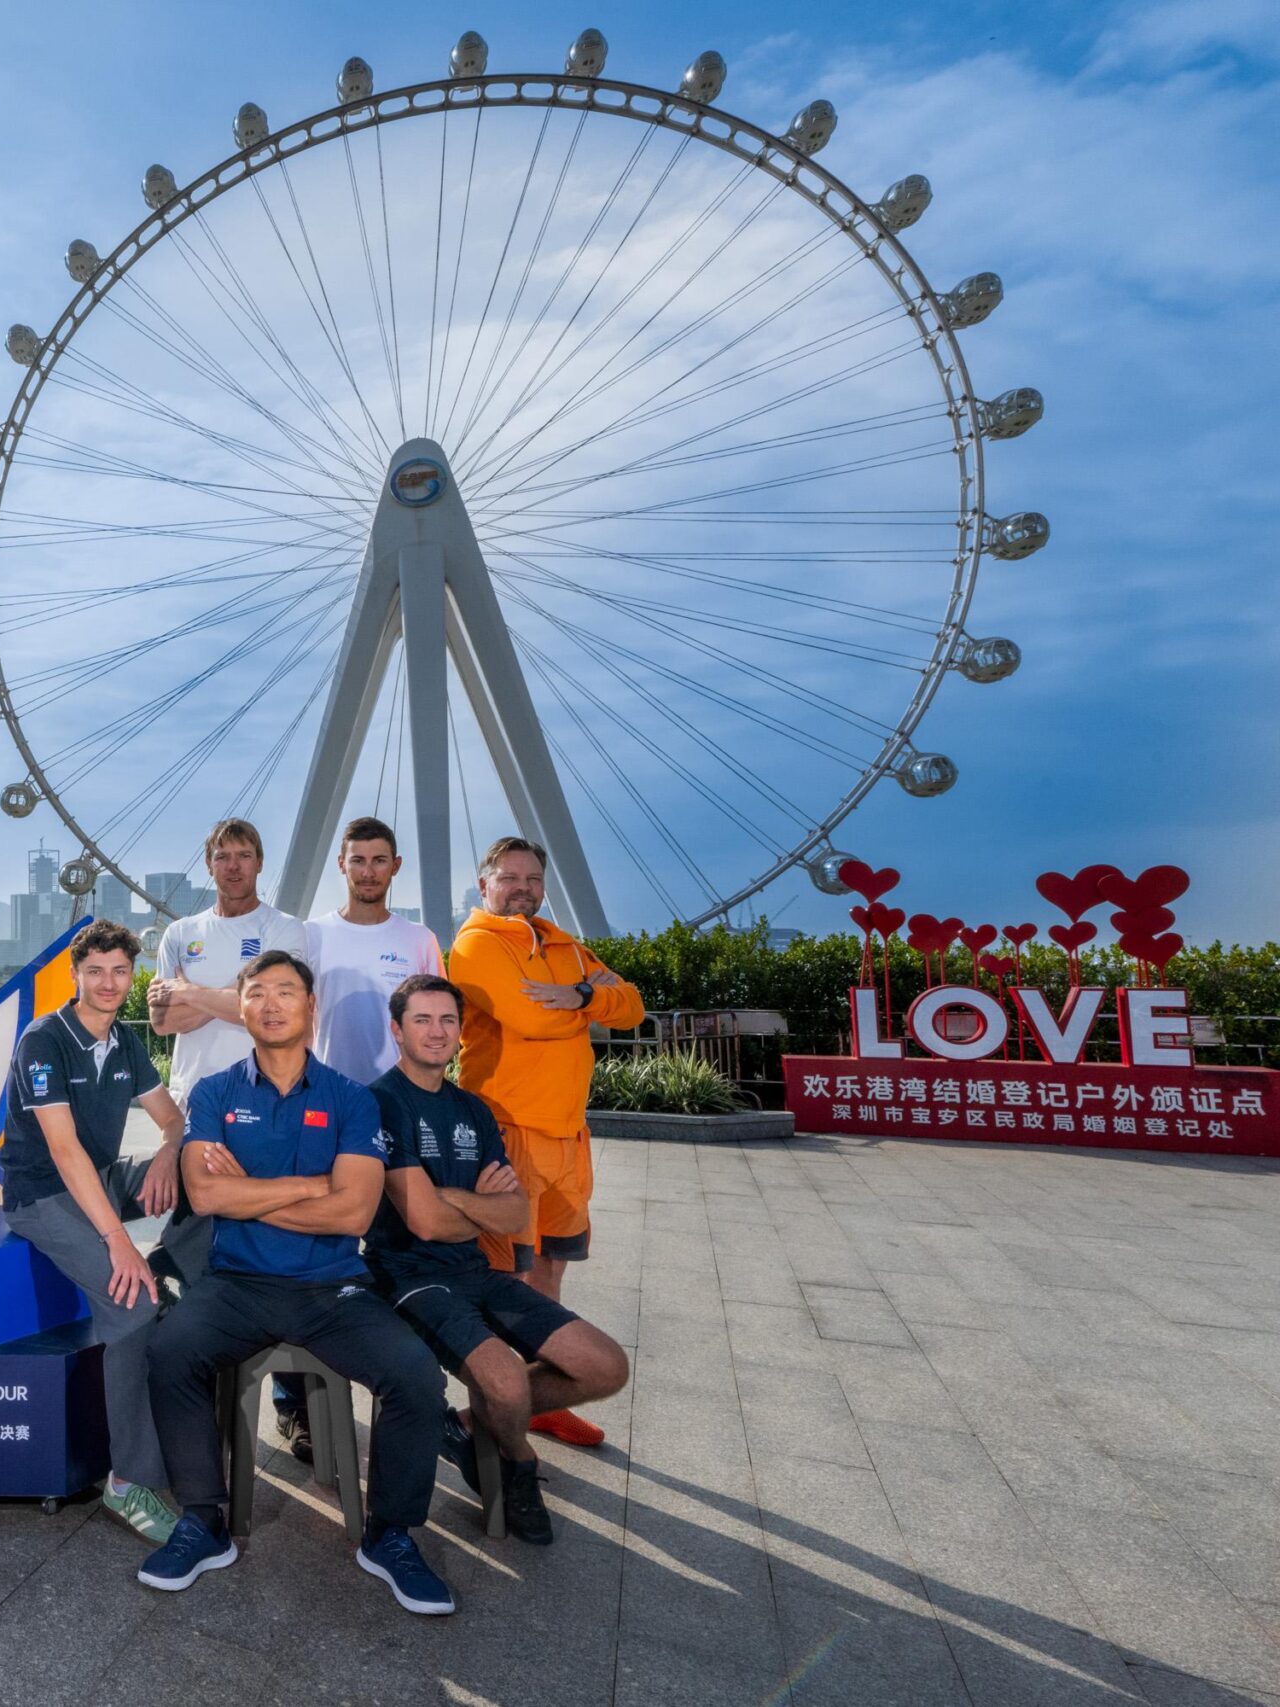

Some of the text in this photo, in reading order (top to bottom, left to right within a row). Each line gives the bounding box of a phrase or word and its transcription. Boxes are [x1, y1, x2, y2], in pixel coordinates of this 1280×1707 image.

[851, 985, 1194, 1067] LOVE
[803, 1073, 1266, 1116] 欢乐港湾结婚登记户外颁证点
[832, 1104, 1235, 1139] 深圳市宝安区民政局婚姻登记处
